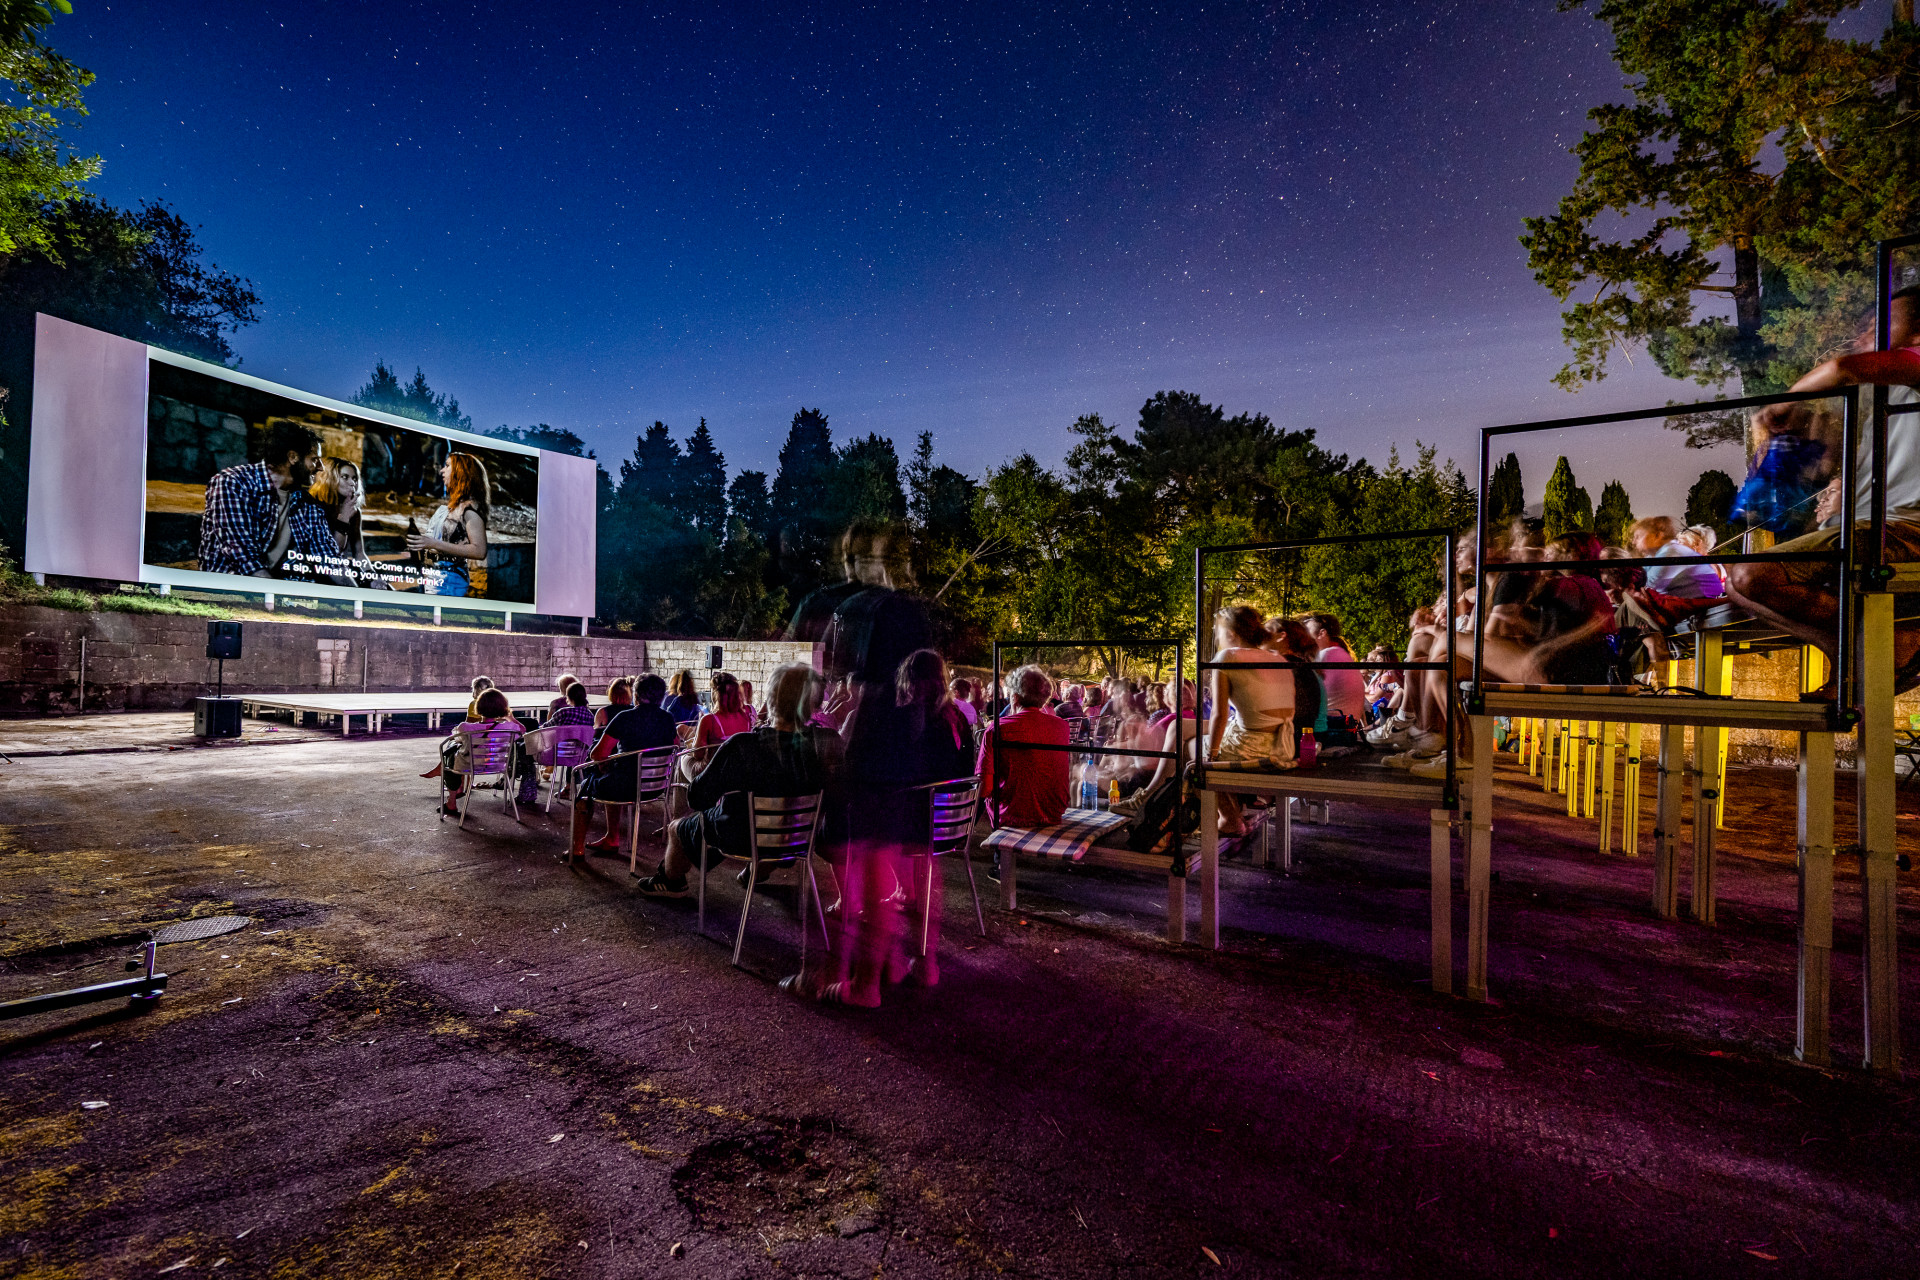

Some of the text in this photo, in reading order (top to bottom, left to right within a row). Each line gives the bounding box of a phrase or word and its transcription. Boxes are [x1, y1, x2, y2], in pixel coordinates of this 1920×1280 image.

[282, 562, 444, 587] a sip. What do you want to drink?
[288, 549, 304, 560] Do
[306, 554, 322, 563] we
[325, 554, 350, 566] have
[352, 558, 368, 568] to?
[404, 565, 420, 575] on,
